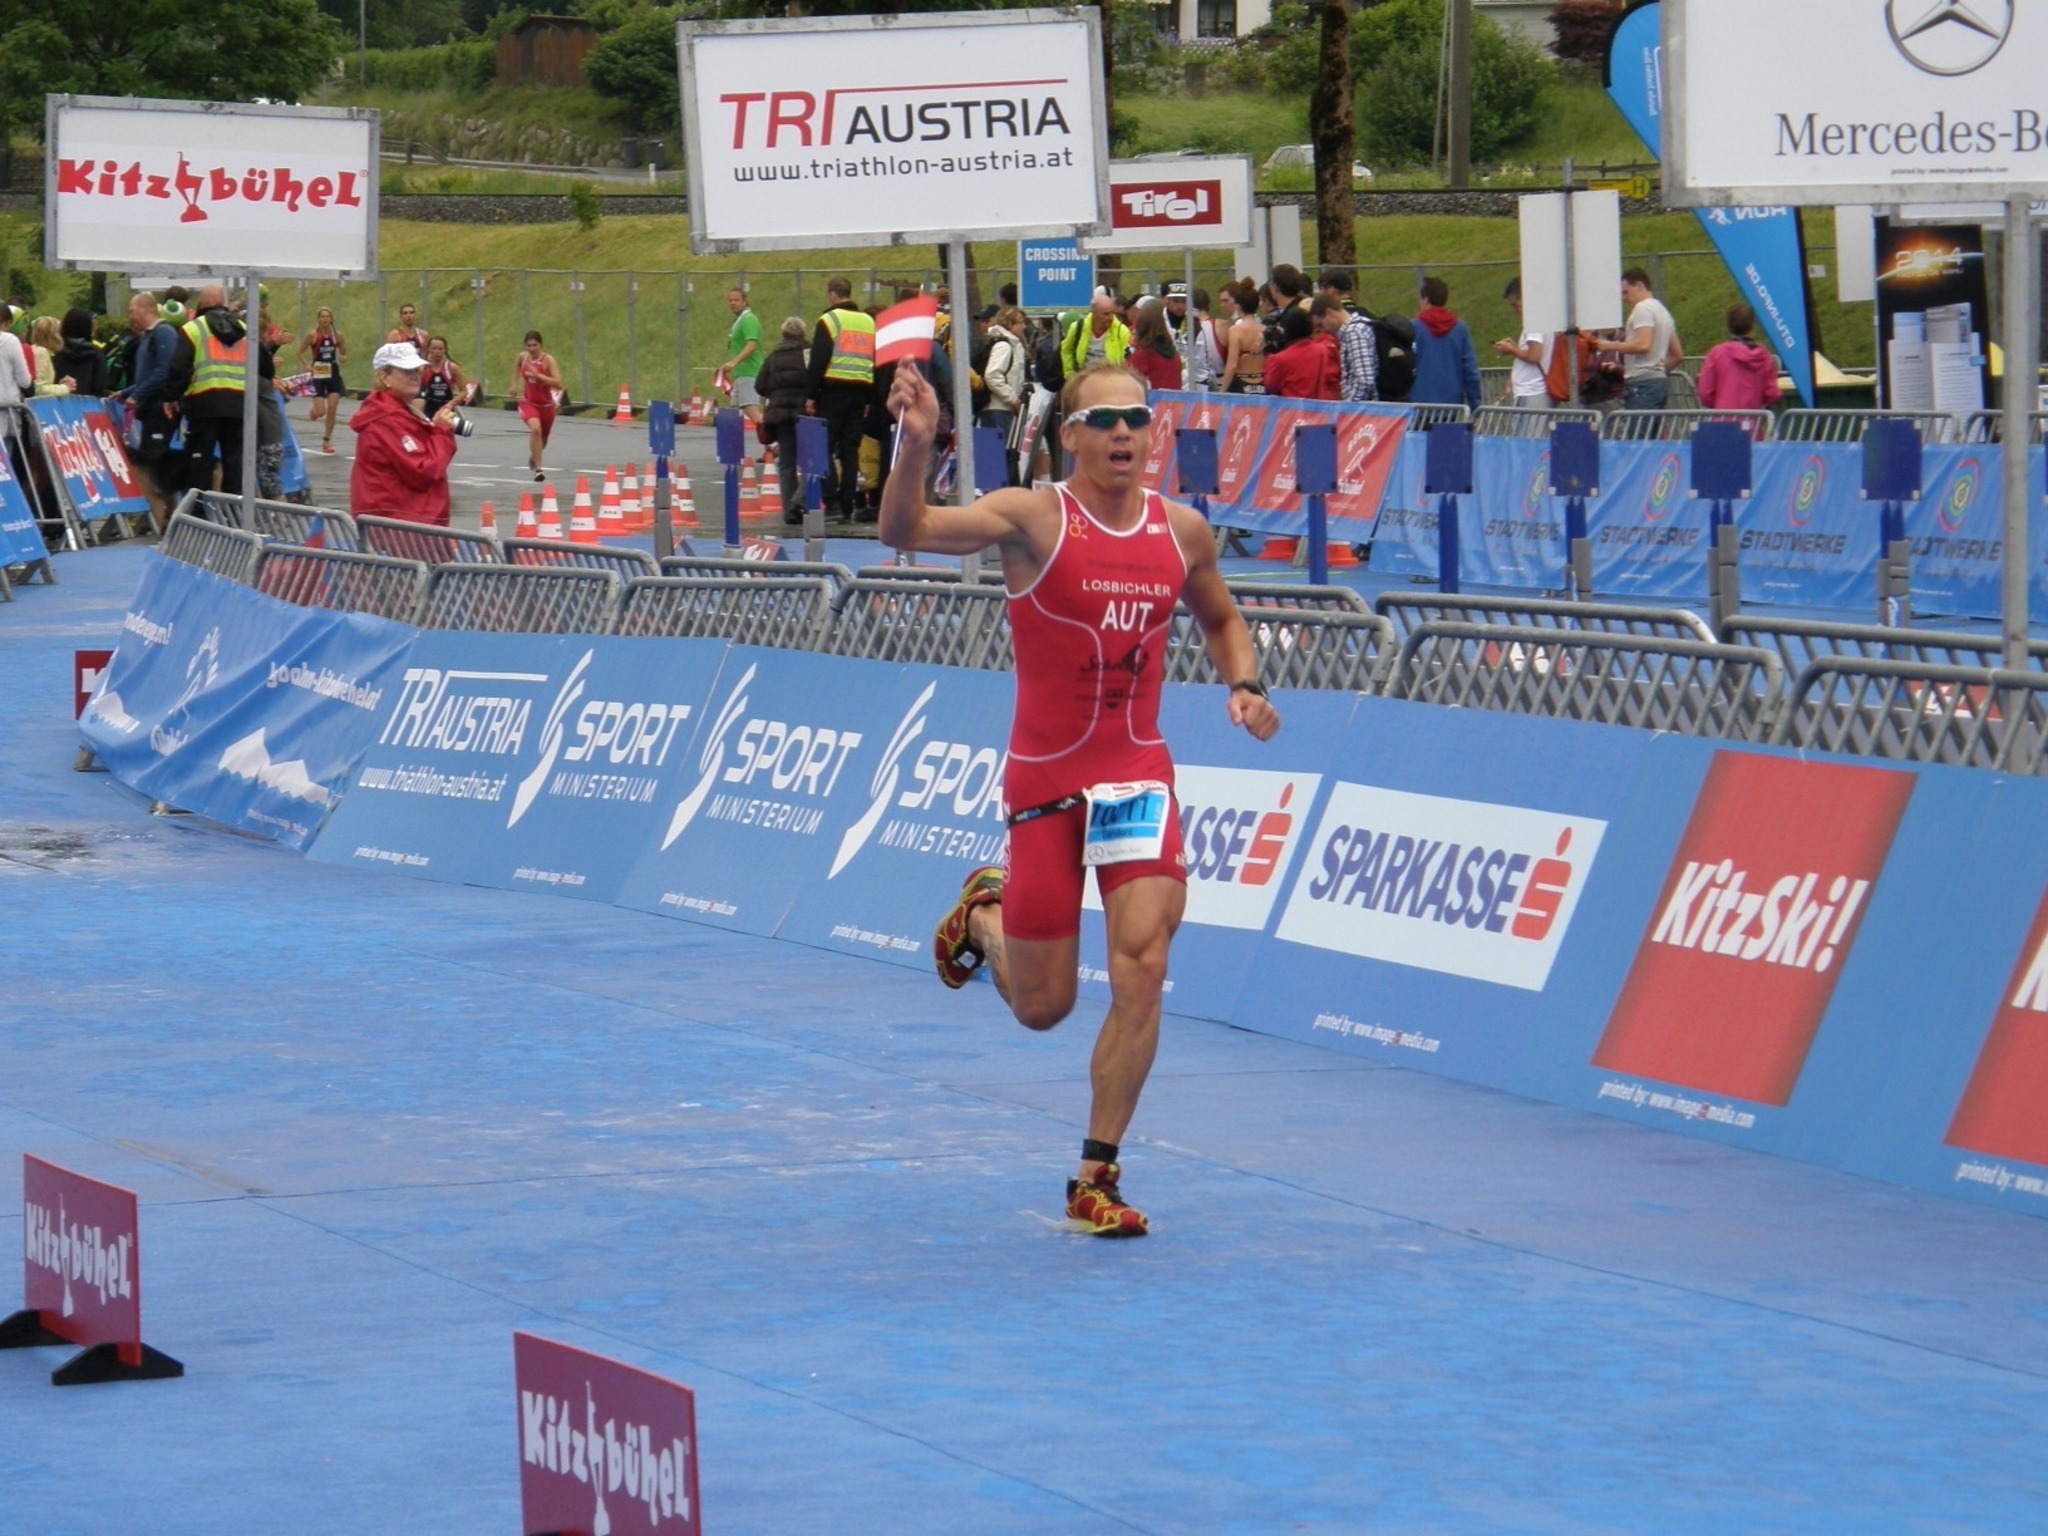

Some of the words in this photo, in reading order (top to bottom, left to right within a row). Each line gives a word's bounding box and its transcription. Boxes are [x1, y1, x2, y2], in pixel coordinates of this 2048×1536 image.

[1775, 109, 2048, 156] Mercedes-B
[733, 146, 1074, 182] www.triathlon-austria.at
[1122, 188, 1209, 220] Tirol
[1038, 267, 1077, 281] POINT
[1740, 530, 1847, 555] STADTWERKE
[1082, 579, 1171, 597] LOSBICHLER
[1101, 600, 1154, 633] AUT
[564, 700, 691, 766] SPORT
[724, 719, 862, 798] SPORT
[358, 764, 508, 802] www.triathlon-austria.at
[549, 773, 657, 803] MINISTERIUM
[706, 794, 823, 835] MINISTERIUM
[1310, 823, 1530, 933] SPARKASSE
[1651, 858, 1869, 972] KitzSki!
